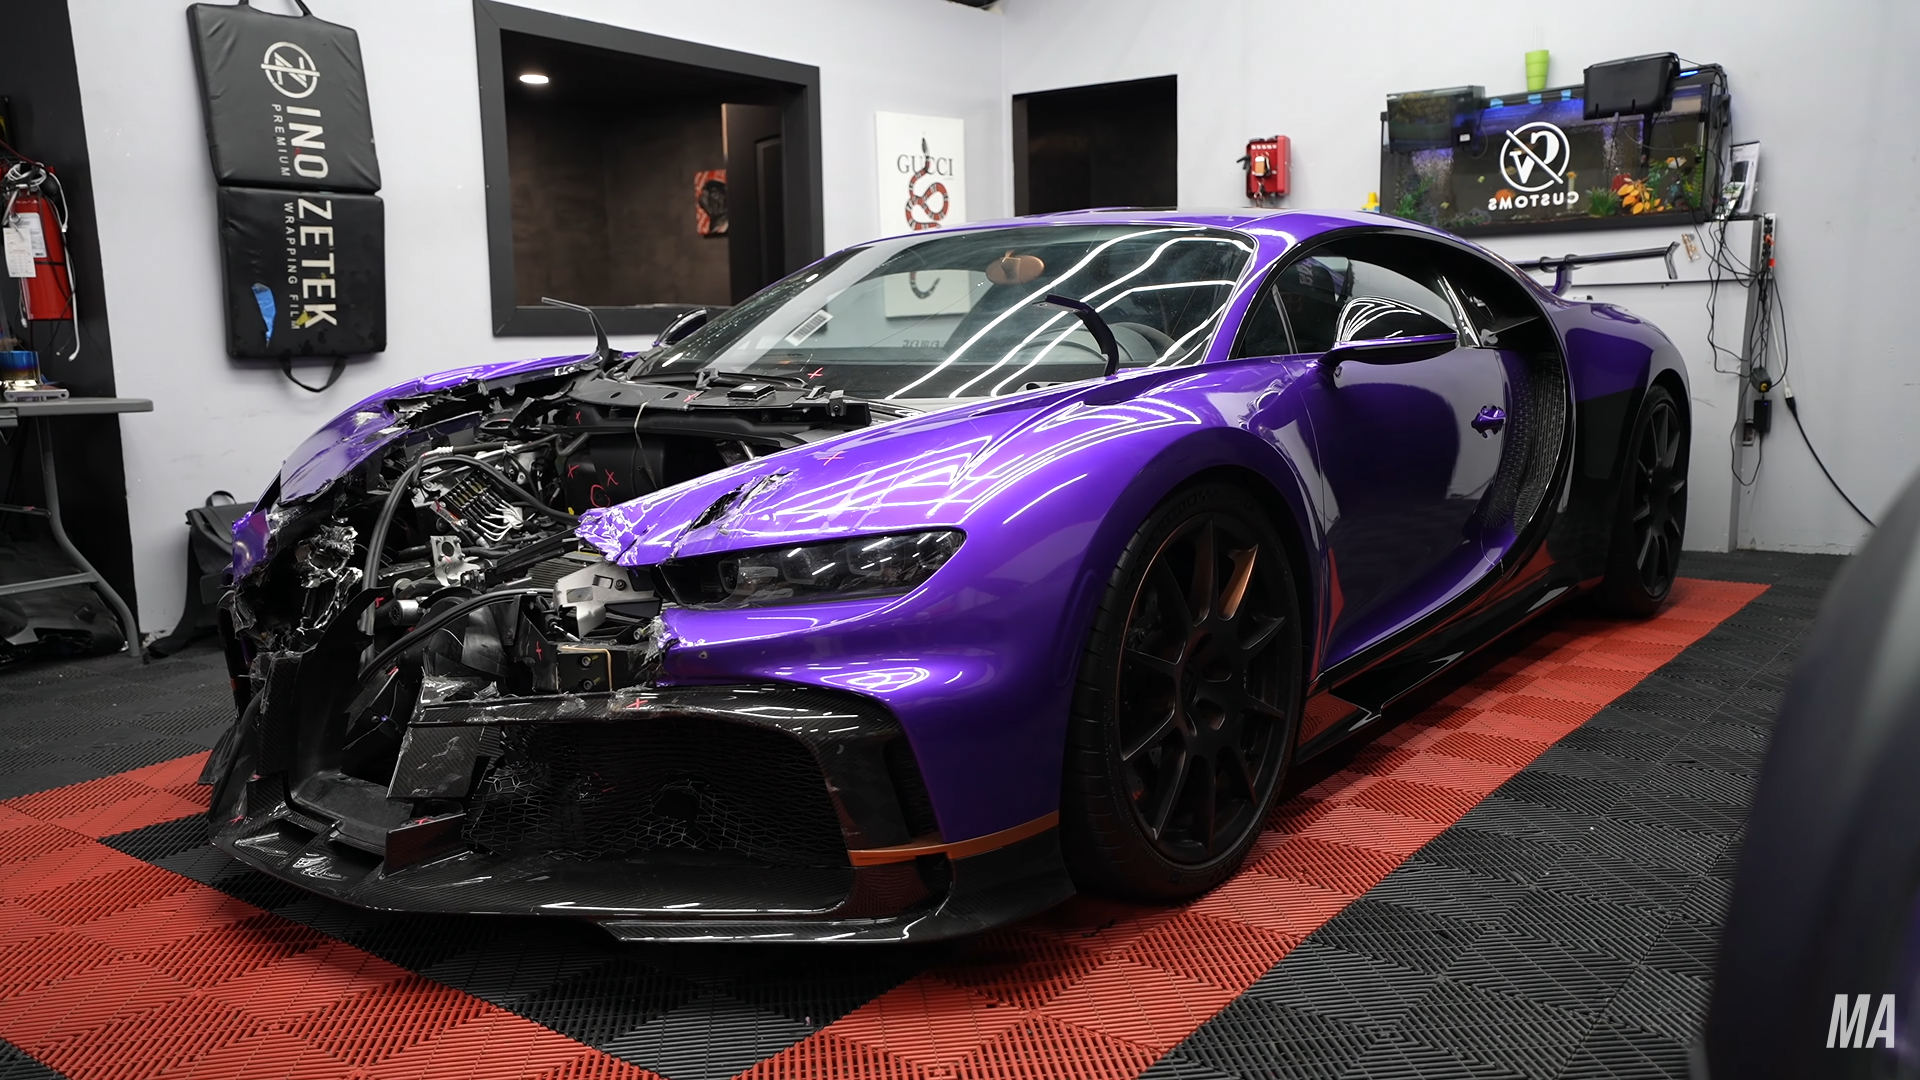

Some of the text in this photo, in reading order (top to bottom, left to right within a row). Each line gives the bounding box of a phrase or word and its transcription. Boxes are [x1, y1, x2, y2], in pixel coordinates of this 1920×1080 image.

[271, 104, 300, 330] PREMIUM WRAPPING FILM
[286, 105, 337, 328] INO ZETEK
[897, 154, 954, 176] GUCCI
